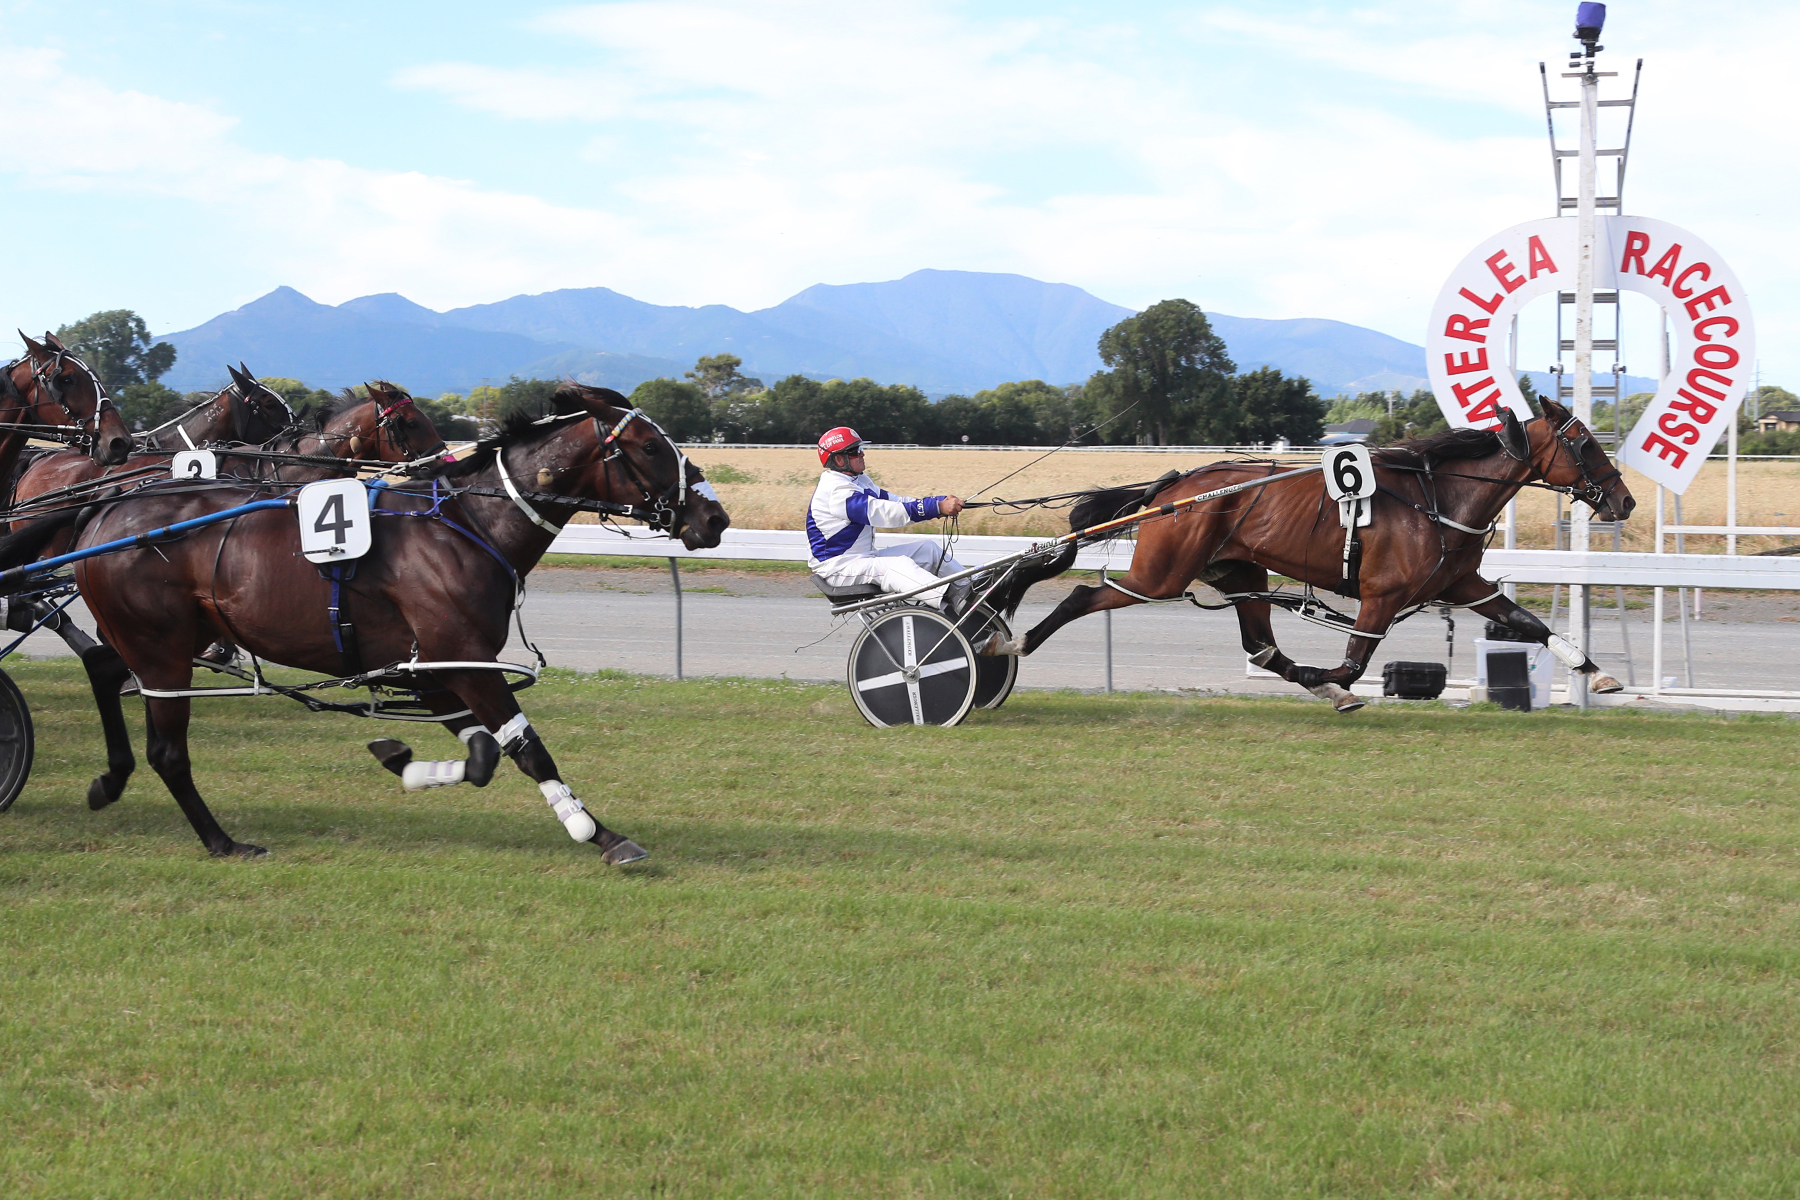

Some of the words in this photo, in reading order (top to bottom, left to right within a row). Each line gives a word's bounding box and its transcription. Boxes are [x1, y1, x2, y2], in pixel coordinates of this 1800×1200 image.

[1444, 235, 1559, 432] ATERLEA
[1620, 230, 1740, 470] RACECOURSE
[1197, 485, 1243, 501] CHALLENGER
[1333, 451, 1362, 495] 6
[314, 494, 353, 544] 4
